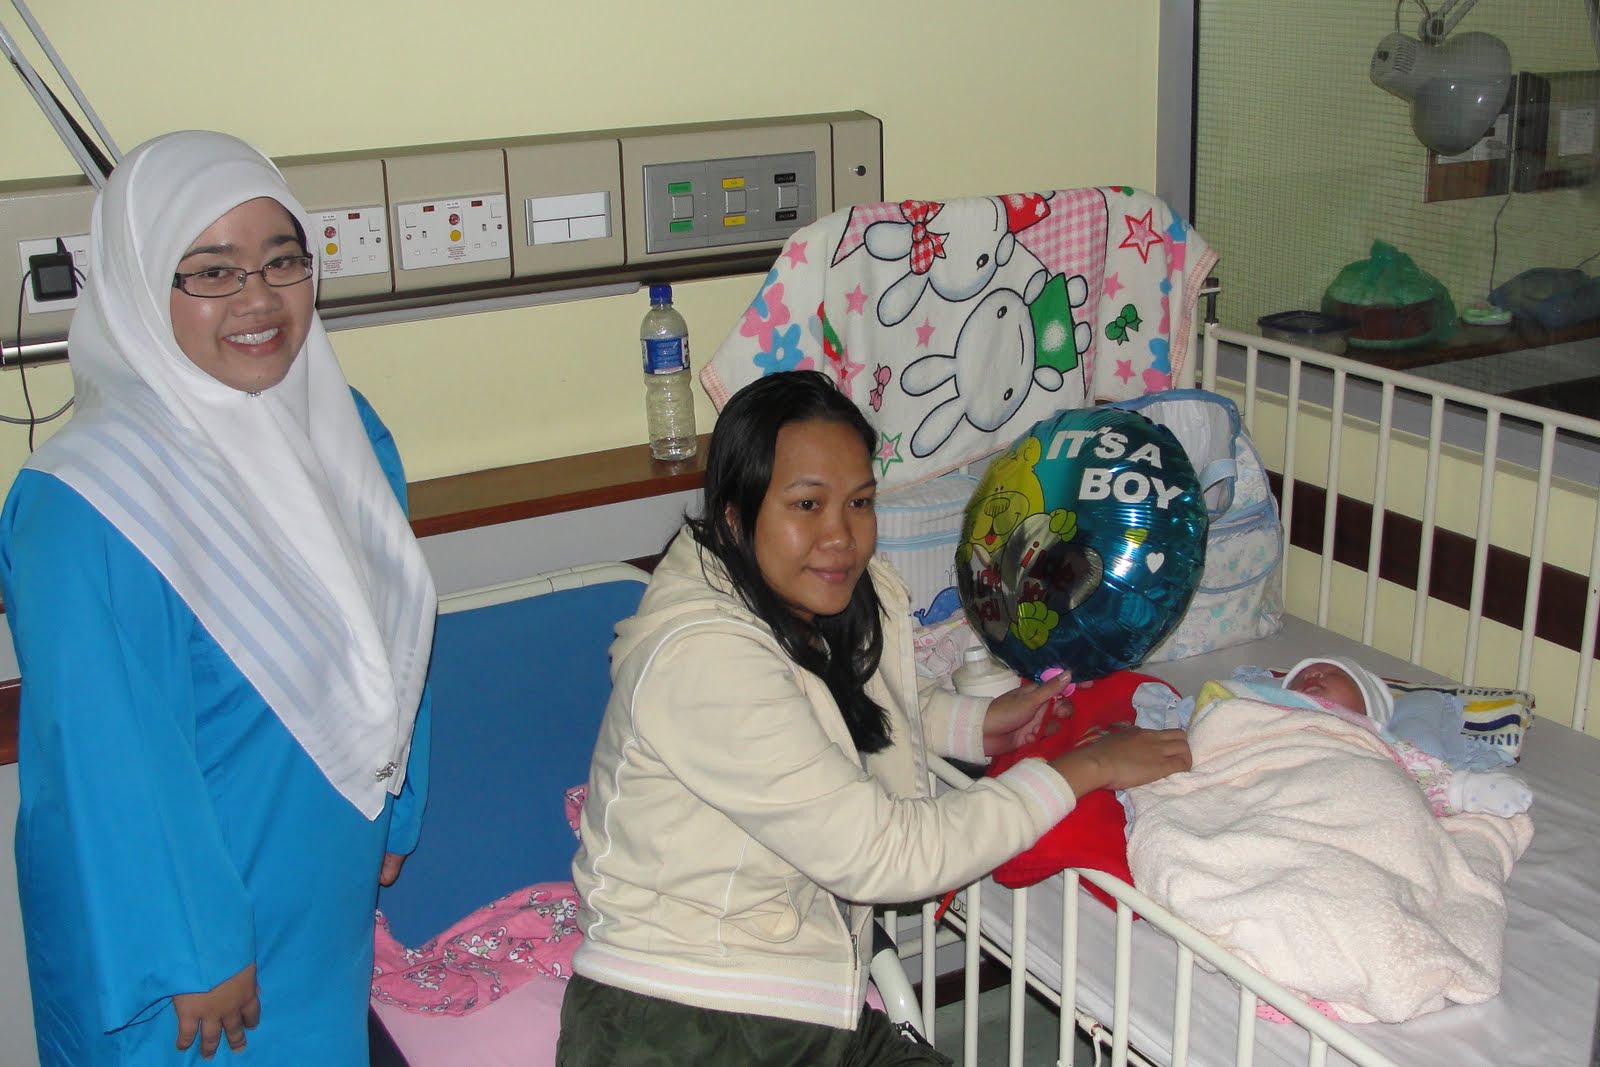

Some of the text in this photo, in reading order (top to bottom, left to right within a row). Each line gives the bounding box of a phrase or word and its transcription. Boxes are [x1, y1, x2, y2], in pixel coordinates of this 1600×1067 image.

[1046, 426, 1163, 469] IT'S A
[1078, 468, 1184, 510] BOY
